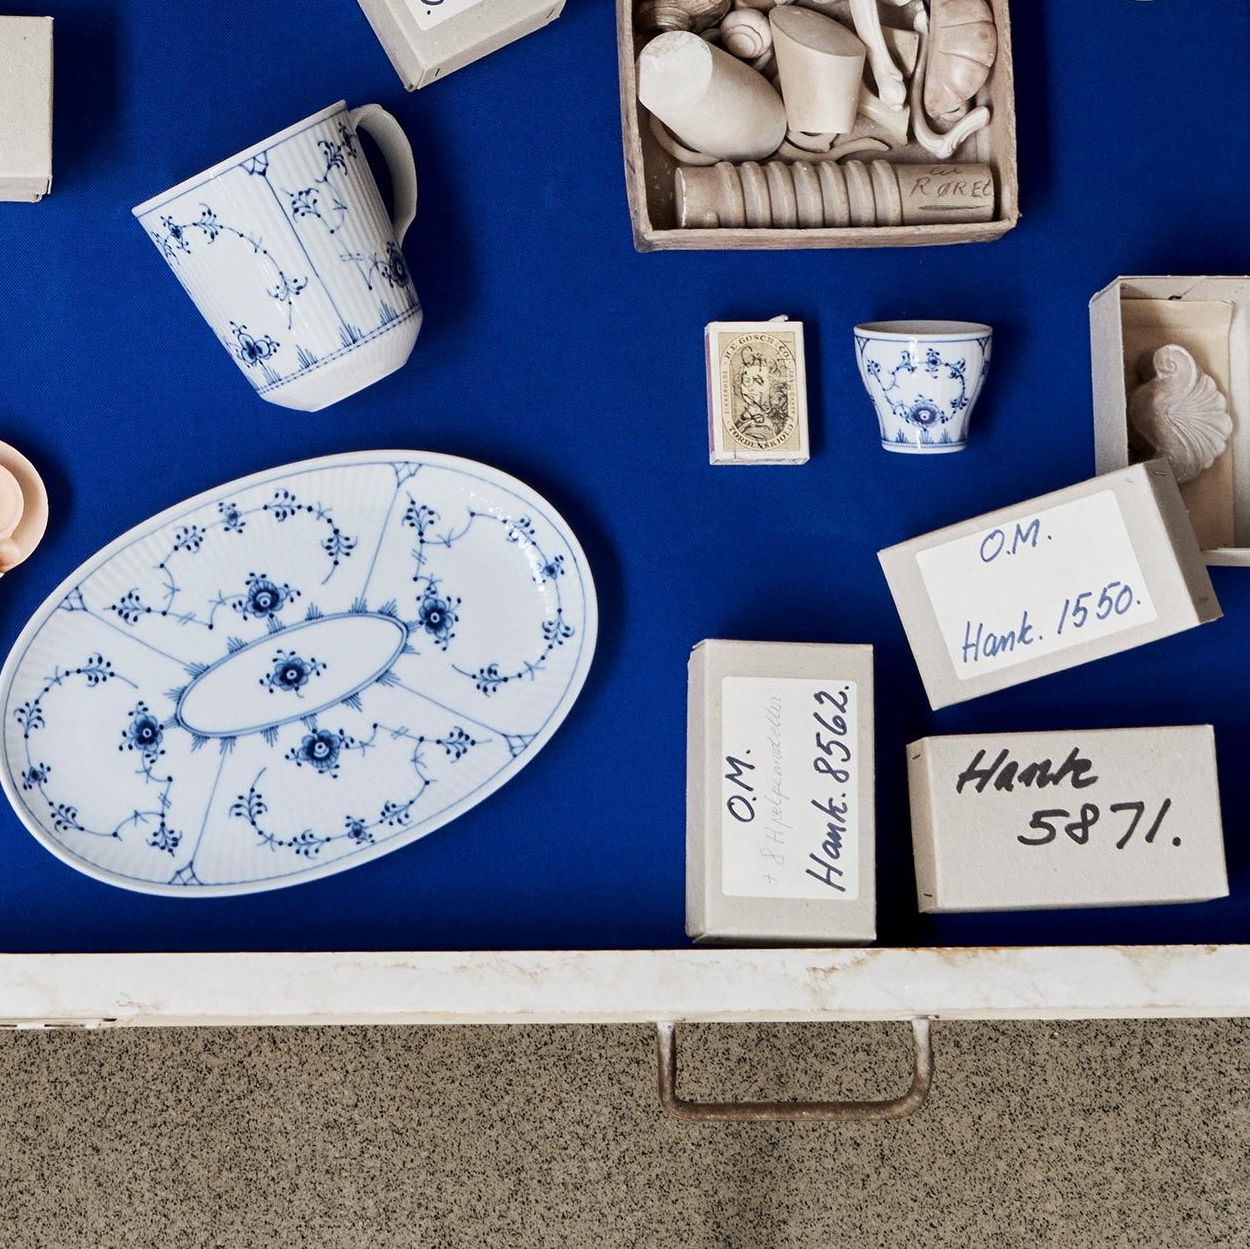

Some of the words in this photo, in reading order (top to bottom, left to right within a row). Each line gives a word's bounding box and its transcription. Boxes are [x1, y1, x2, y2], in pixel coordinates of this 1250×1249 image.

[980, 518, 1052, 562] O.M.
[1056, 581, 1141, 635] 1550.
[812, 685, 851, 783] 8562.
[724, 749, 757, 823] O.M.
[1017, 798, 1181, 849] 5871.
